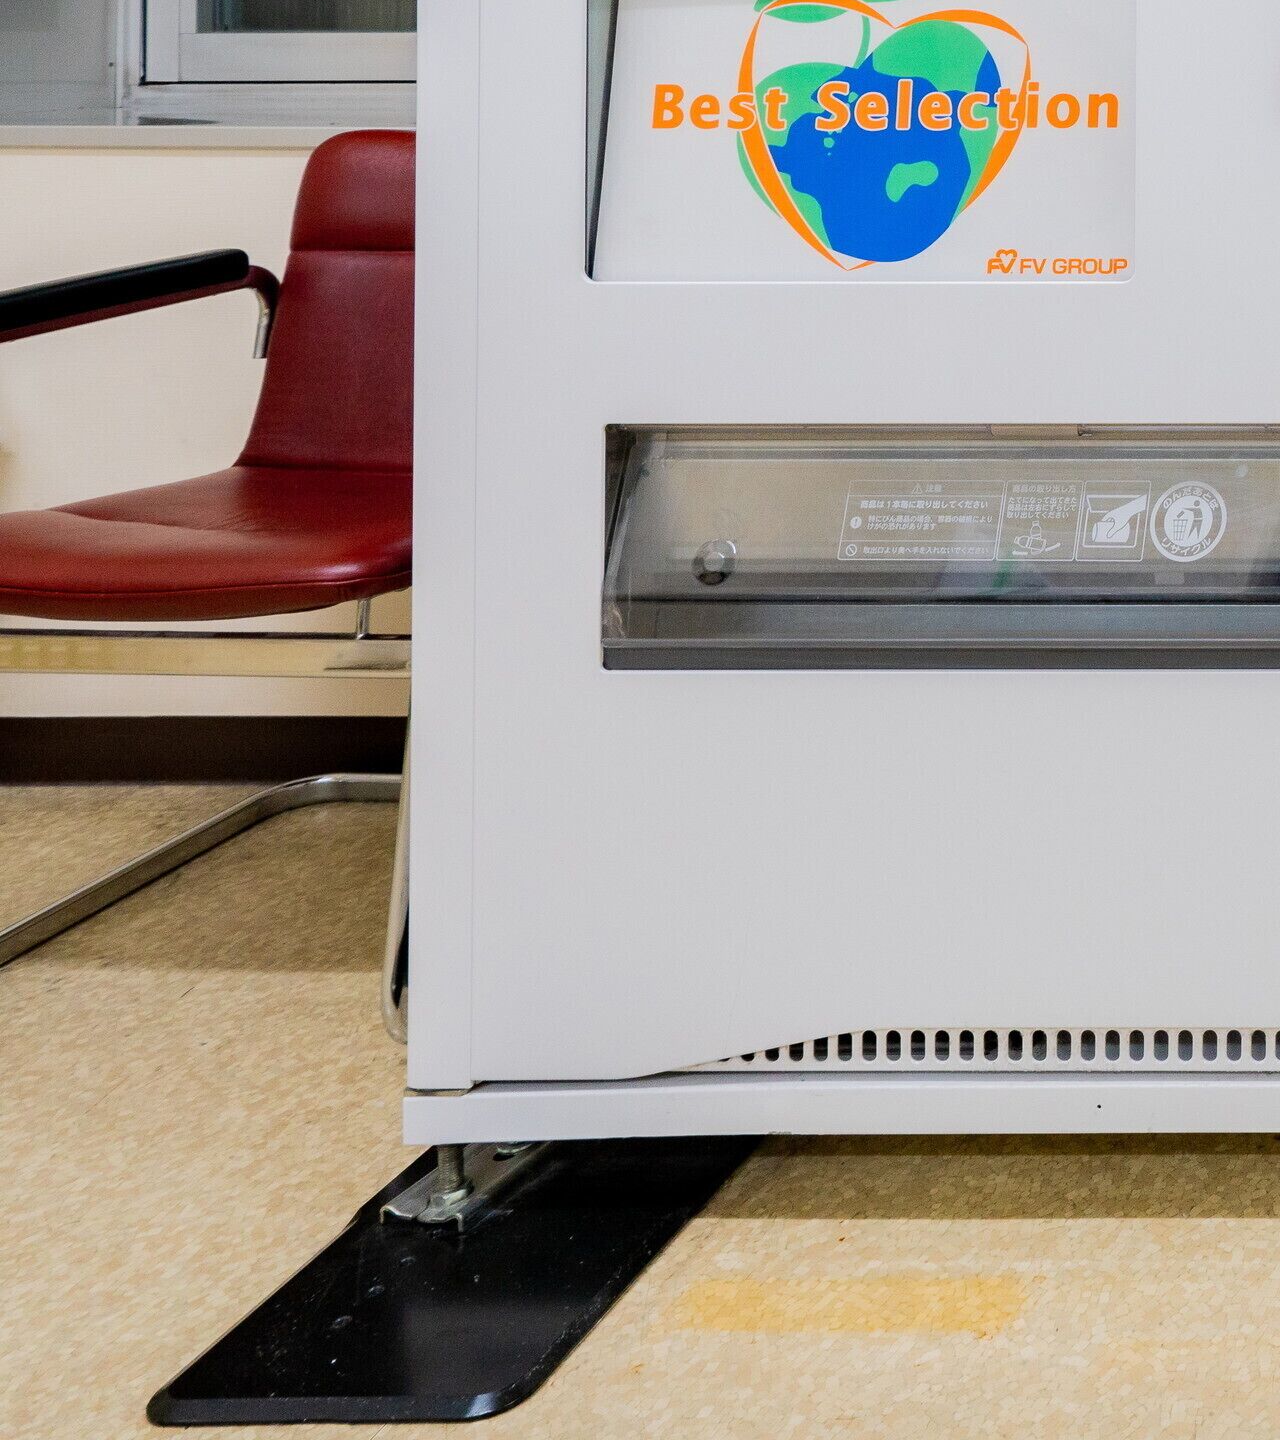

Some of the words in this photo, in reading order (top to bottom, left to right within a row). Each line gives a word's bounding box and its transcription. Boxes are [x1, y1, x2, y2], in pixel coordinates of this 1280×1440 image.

[651, 83, 788, 131] Best
[815, 80, 1119, 132] Selection
[1020, 258, 1048, 274] FV
[1051, 258, 1128, 275] GROUP
